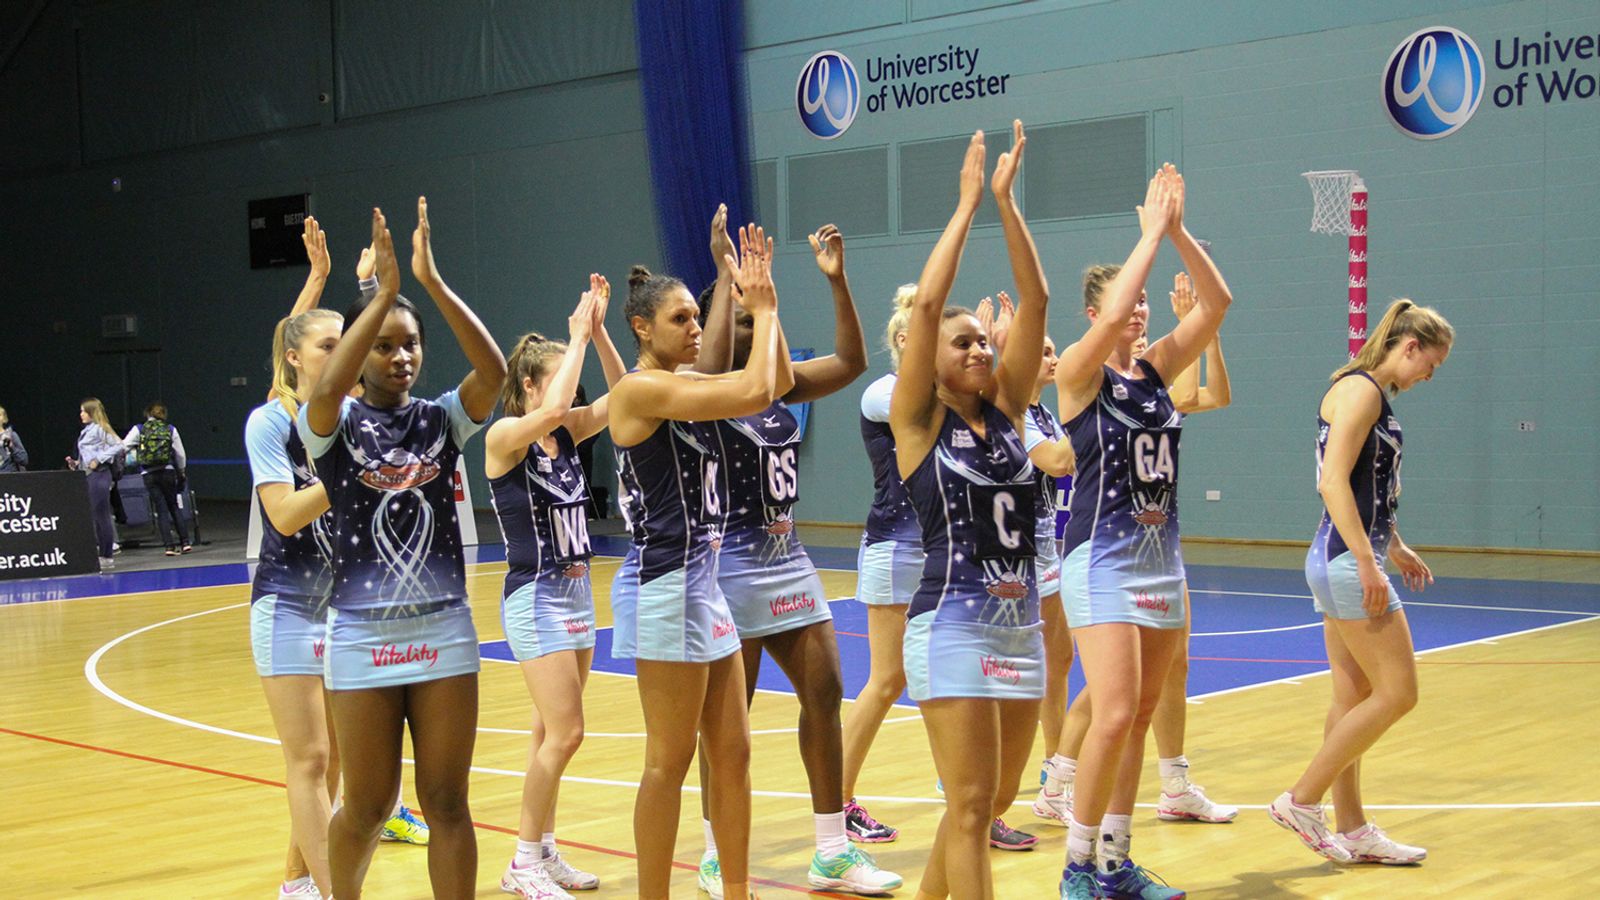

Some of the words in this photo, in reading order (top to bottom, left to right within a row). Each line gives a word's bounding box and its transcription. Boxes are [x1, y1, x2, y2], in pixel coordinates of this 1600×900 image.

[867, 45, 979, 83] University
[1495, 32, 1600, 70] Unive
[866, 85, 888, 113] of
[892, 74, 1010, 109] Worcester
[1493, 72, 1529, 108] of
[1535, 68, 1600, 103] Wo
[767, 448, 797, 501] GS
[1134, 433, 1174, 484] GA
[0, 514, 60, 534] cester
[554, 504, 591, 558] WA
[993, 491, 1020, 549] C
[769, 592, 815, 617] Vitality
[371, 641, 438, 669] Vitality
[980, 655, 1022, 686] Vitality
